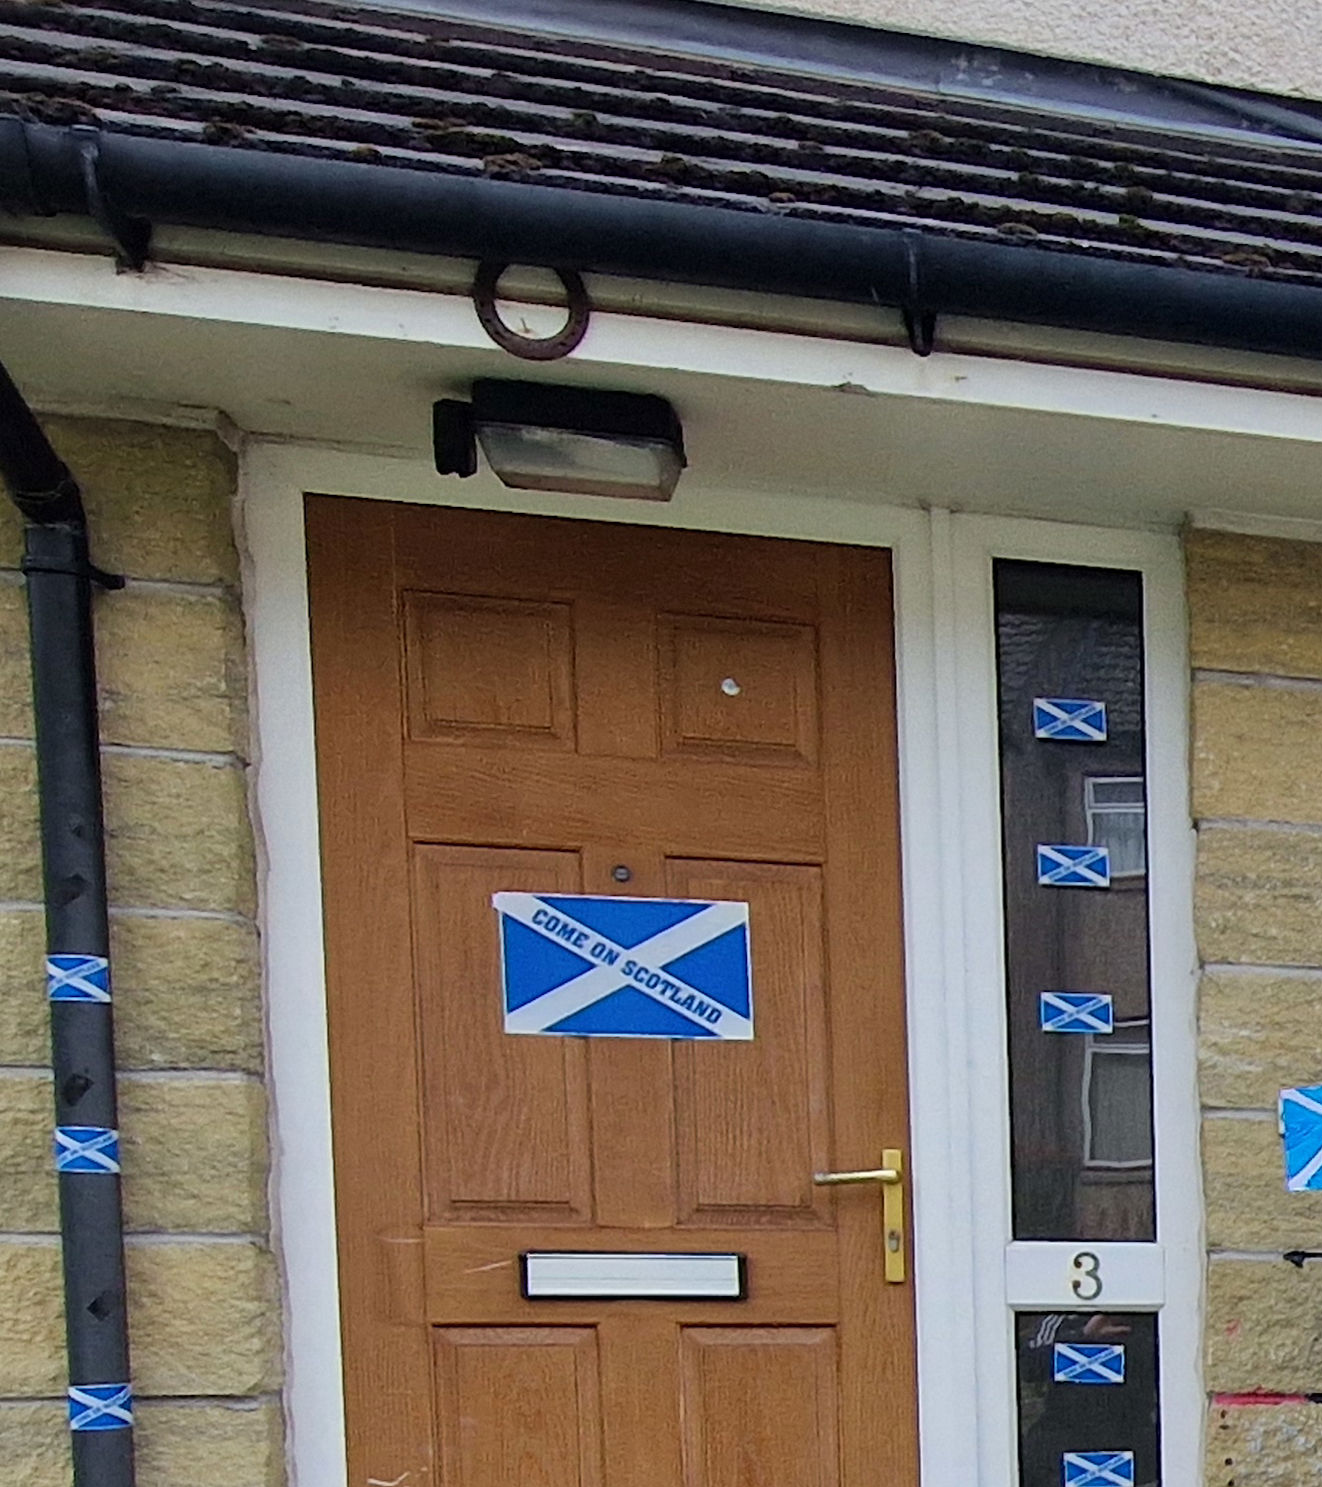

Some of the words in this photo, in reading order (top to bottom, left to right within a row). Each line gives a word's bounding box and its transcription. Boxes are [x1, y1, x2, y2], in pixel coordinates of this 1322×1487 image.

[531, 908, 591, 948] COME
[590, 942, 621, 966] ON
[621, 959, 723, 1025] SCOTLAND
[1072, 1252, 1102, 1300] 3
